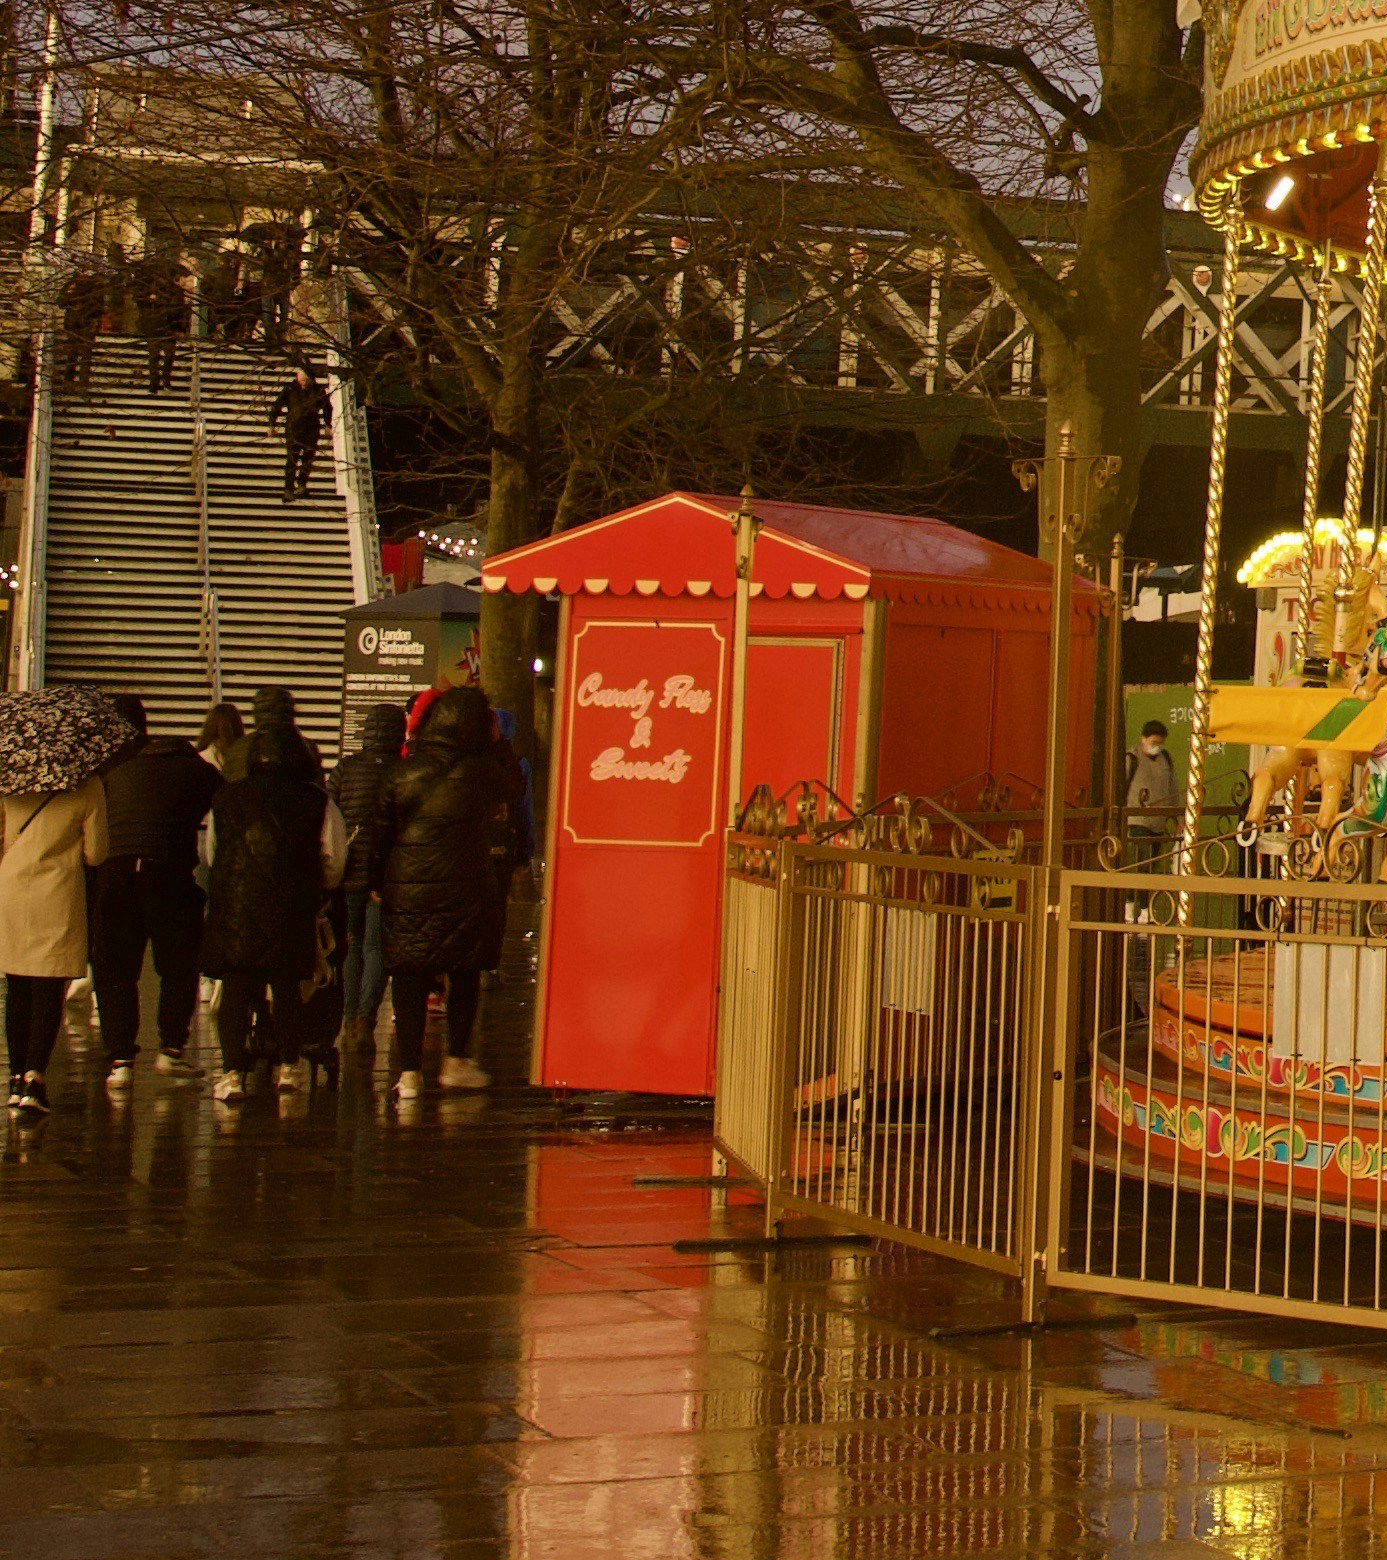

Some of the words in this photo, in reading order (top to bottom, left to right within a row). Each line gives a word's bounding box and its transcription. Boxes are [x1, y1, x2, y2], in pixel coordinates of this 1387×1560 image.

[379, 627, 412, 642] London
[577, 672, 655, 719] Candy
[658, 674, 712, 714] Floss
[629, 716, 652, 748] &
[589, 746, 692, 783] Sweets
